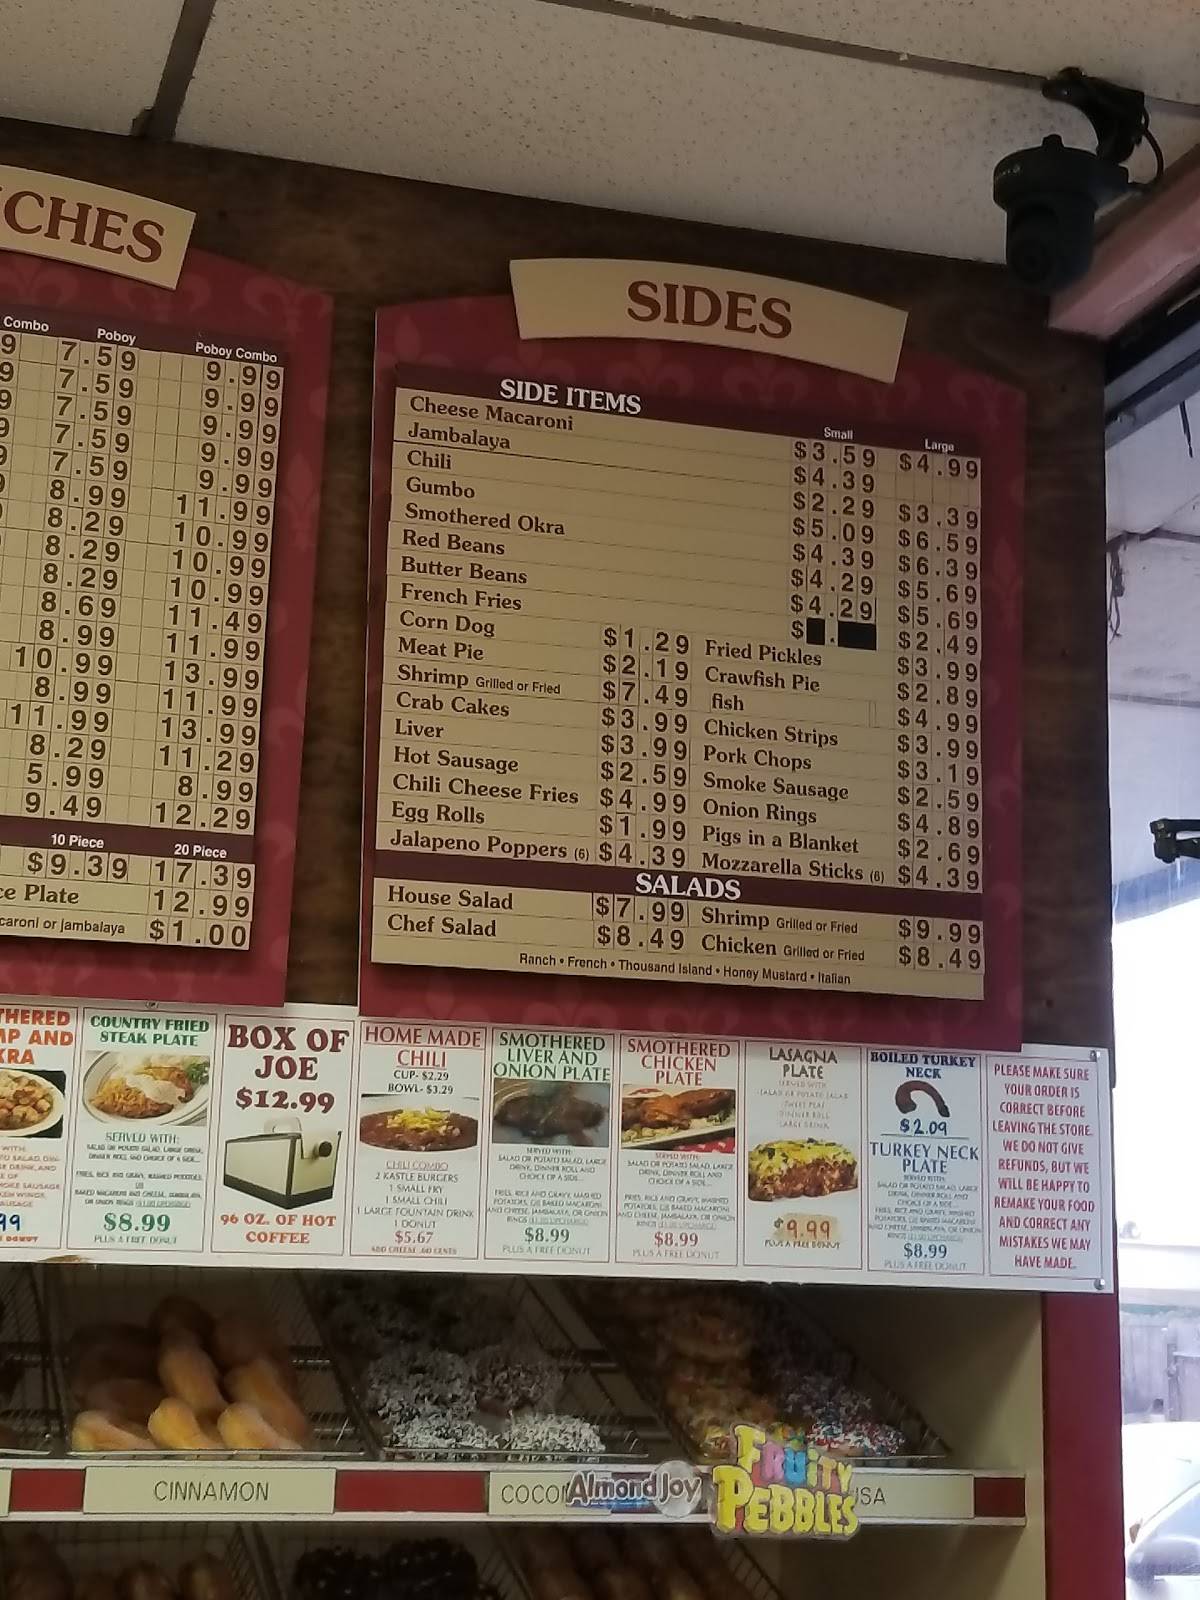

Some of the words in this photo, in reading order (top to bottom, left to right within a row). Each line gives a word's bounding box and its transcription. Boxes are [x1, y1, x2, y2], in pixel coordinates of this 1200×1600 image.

[0, 187, 164, 263] CHES
[627, 280, 792, 338] SIDES
[4, 316, 50, 332] Combo
[97, 329, 136, 345] Poboy
[61, 341, 136, 371] 7.59
[195, 341, 232, 359] Poboy
[236, 348, 278, 363] Combo
[207, 361, 280, 390] 9.99
[500, 378, 559, 405] SIDE
[566, 386, 642, 415] ITEMS
[410, 395, 479, 418] Cheese
[485, 405, 573, 430] Macaroni
[408, 422, 511, 450] Jambalaya
[824, 427, 853, 440] Small
[793, 440, 875, 468] $3.59
[925, 438, 955, 453] Large
[407, 449, 452, 470] Chili
[900, 453, 978, 479] $4.99
[406, 476, 475, 498] Gumbo
[177, 494, 271, 525] 11.99
[405, 502, 511, 530] Smothered
[518, 515, 565, 535] Okra
[793, 517, 874, 545] $5.09
[168, 604, 262, 633] 11.49
[16, 646, 113, 676] 10.99
[705, 639, 752, 660] Fried
[758, 645, 822, 666] Pickles
[164, 660, 260, 690] 13.99
[397, 664, 469, 689] Shrimp
[476, 676, 514, 690] Grilled
[517, 681, 529, 691] or
[532, 681, 560, 694] Fried
[603, 681, 688, 708] $7.49
[712, 693, 744, 711] fish
[155, 802, 251, 830] 12.29
[50, 833, 66, 846] 10
[69, 834, 104, 849] Piece
[390, 829, 480, 856] Jalapeno
[487, 835, 567, 859] Poppers
[702, 825, 741, 846] Pigs
[749, 830, 764, 845] in
[772, 835, 781, 847] a
[789, 833, 859, 853] Blanket
[174, 844, 190, 856] 20
[192, 845, 227, 858] Piece
[27, 851, 128, 880] $9.39
[151, 860, 251, 889] 17.39
[701, 853, 801, 875] Mozzarella
[809, 861, 863, 880] Sticks
[635, 872, 741, 900] SALADS
[898, 865, 979, 889] $4.39
[388, 886, 451, 906] House
[458, 890, 513, 910] Salad
[596, 896, 685, 922] $7.99
[43, 919, 57, 930] or
[60, 918, 125, 936] jambalaya
[150, 919, 246, 947] $1.00
[899, 919, 980, 943] $9.99
[519, 953, 556, 966] Ranch
[567, 956, 607, 968] French
[619, 958, 675, 974] Thousand
[679, 963, 712, 976] Island
[724, 967, 758, 982] Honey
[762, 969, 806, 983] Mustard
[818, 971, 850, 984] Italian
[90, 1015, 160, 1030] COUNTRY
[165, 1019, 209, 1032] FRIED
[100, 1031, 147, 1044] STEAK
[152, 1034, 198, 1046] PLATE
[227, 1024, 296, 1050] BOX
[307, 1029, 349, 1052] OF
[364, 1026, 421, 1044] HOME
[427, 1029, 481, 1047] MADE
[500, 1032, 606, 1051] SMOTHERED
[508, 1049, 555, 1063] LIVER
[559, 1051, 597, 1066] AND
[627, 1039, 731, 1057] SMOTHERED
[769, 1047, 837, 1064] LASAGNA
[255, 1056, 318, 1080] JOE
[397, 1050, 447, 1068] CHILI
[641, 1055, 716, 1072] CHICKEN
[870, 1051, 918, 1064] BOILED
[923, 1054, 976, 1068] TURKEY
[394, 1069, 419, 1080] CUP-
[422, 1070, 449, 1081] $2.29
[493, 1062, 556, 1079] ONION
[563, 1067, 610, 1081] PLATE
[655, 1070, 702, 1086] PLATE
[783, 1064, 823, 1079] PLATE
[906, 1067, 942, 1079] NECK
[994, 1064, 1031, 1077] PLEASE
[1032, 1066, 1061, 1079] MAKE
[1063, 1068, 1089, 1080] SURE
[388, 1083, 423, 1093] BOWL-
[427, 1084, 453, 1095] $3.29
[1005, 1083, 1032, 1097] YOUR
[1034, 1085, 1068, 1098] ORDER
[1071, 1087, 1080, 1098] IS
[236, 1087, 335, 1113] $12.99
[1000, 1101, 1044, 1115] CORRECT
[1047, 1104, 1085, 1117] BEFORE
[900, 1118, 947, 1136] $2.09
[992, 1120, 1036, 1134] LEAVING
[1037, 1122, 1058, 1135] THE
[870, 1141, 931, 1159] TURKEY
[937, 1145, 979, 1160] NECK
[1003, 1140, 1019, 1152] WE
[1021, 1140, 1035, 1153] DO
[1038, 1141, 1059, 1155] NOT
[1061, 1143, 1083, 1155] GIVE
[902, 1159, 948, 1173] PLATE
[998, 1158, 1049, 1174] REFUNDS,
[1051, 1160, 1070, 1173] BUT
[1073, 1162, 1089, 1174] WE
[998, 1178, 1023, 1191] WILL
[1026, 1178, 1039, 1191] BE
[1042, 1179, 1075, 1192] HAPPY
[1076, 1180, 1089, 1193] TO
[994, 1196, 1036, 1210] REMAKE
[1037, 1198, 1065, 1211] YOUR
[1068, 1199, 1094, 1212] FOOD
[103, 1213, 170, 1232] $8.99
[220, 1214, 238, 1225] 96
[244, 1214, 269, 1225] OZ.
[276, 1215, 297, 1226] OF
[303, 1216, 336, 1227] HOT
[999, 1215, 1021, 1228] AND
[1023, 1217, 1068, 1230] CORRECT
[1070, 1219, 1091, 1232] ANY
[246, 1231, 310, 1244] COFFEE
[395, 1231, 433, 1244] $5.67
[524, 1227, 570, 1243] $8.99
[654, 1231, 699, 1247] $8.99
[999, 1235, 1049, 1249] MISTAKES
[1051, 1237, 1067, 1249] WE
[1069, 1237, 1091, 1251] MAY
[903, 1243, 947, 1258] $8.99
[1014, 1255, 1041, 1268] HAVE
[154, 1480, 270, 1502] CINNAMON
[501, 1484, 567, 1504] COCO
[568, 1471, 655, 1505] Almond
[657, 1474, 701, 1503] Joy
[713, 1465, 859, 1536] PEBBLES
